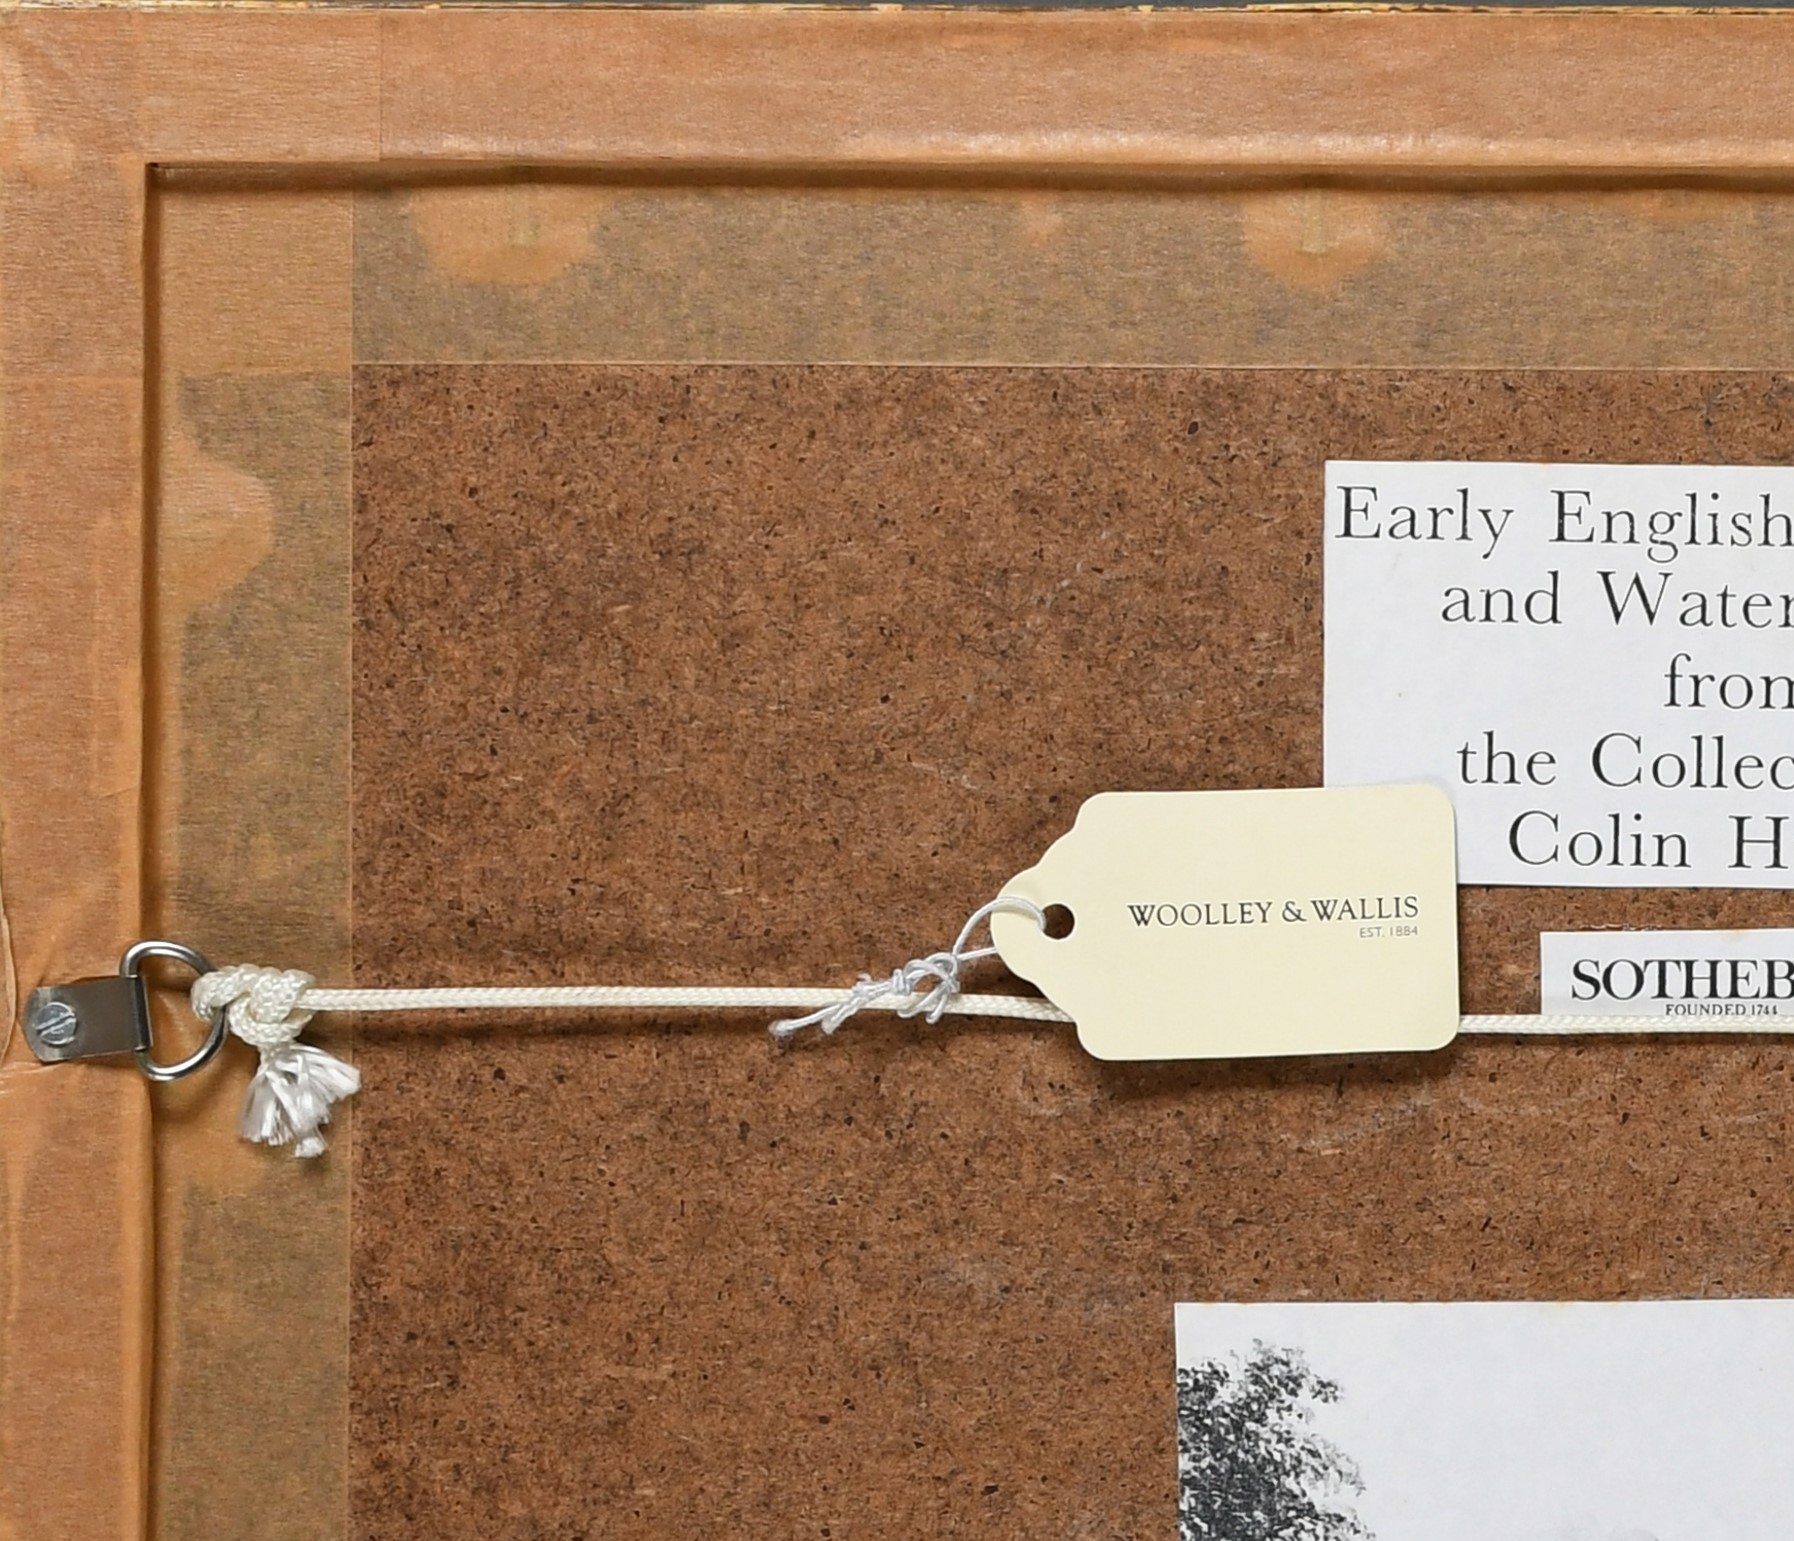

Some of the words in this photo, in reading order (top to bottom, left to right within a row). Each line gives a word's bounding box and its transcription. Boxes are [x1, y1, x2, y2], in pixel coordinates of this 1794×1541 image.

[1334, 485, 1515, 560] Early
[1441, 569, 1563, 625] and
[1459, 729, 1557, 786] the
[1508, 810, 1692, 869] Colin
[1126, 901, 1273, 927] WOOLLEY
[1281, 900, 1307, 923] &
[1310, 895, 1420, 922] WALLIS
[1358, 926, 1386, 938] EST.
[1389, 925, 1419, 938] 1884
[1664, 1003, 1747, 1015] FOUNDED
[1750, 1003, 1779, 1015] 1744
